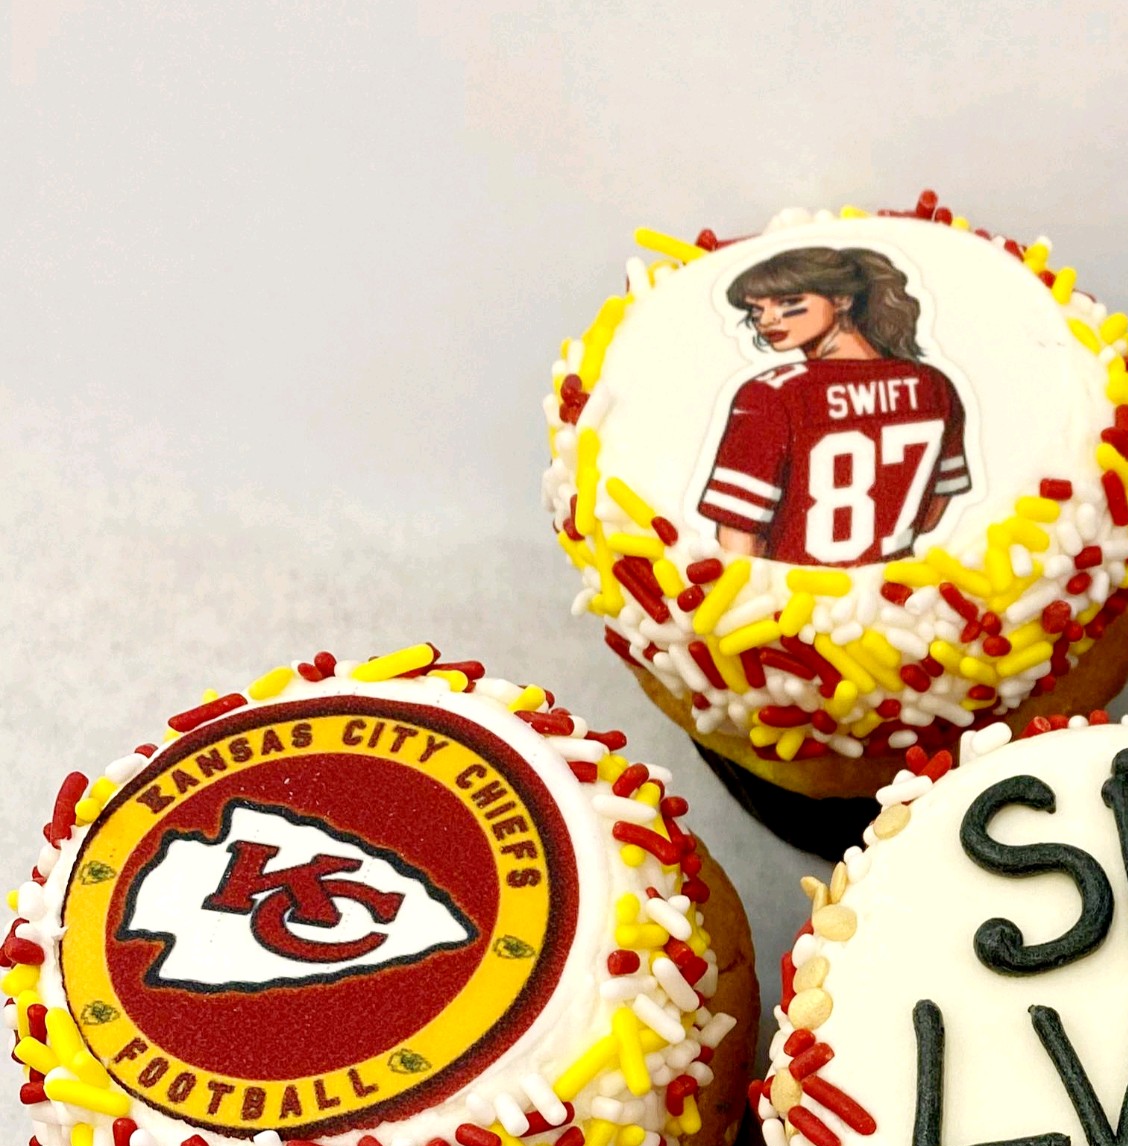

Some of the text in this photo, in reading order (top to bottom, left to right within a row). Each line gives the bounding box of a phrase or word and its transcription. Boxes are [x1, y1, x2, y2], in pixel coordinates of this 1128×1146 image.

[826, 377, 920, 419] SWIFT
[804, 419, 945, 563] 87
[135, 718, 542, 889] KANSAS CITY CHIEFS
[201, 840, 407, 964] KC
[111, 1037, 380, 1121] FOOTBALL
